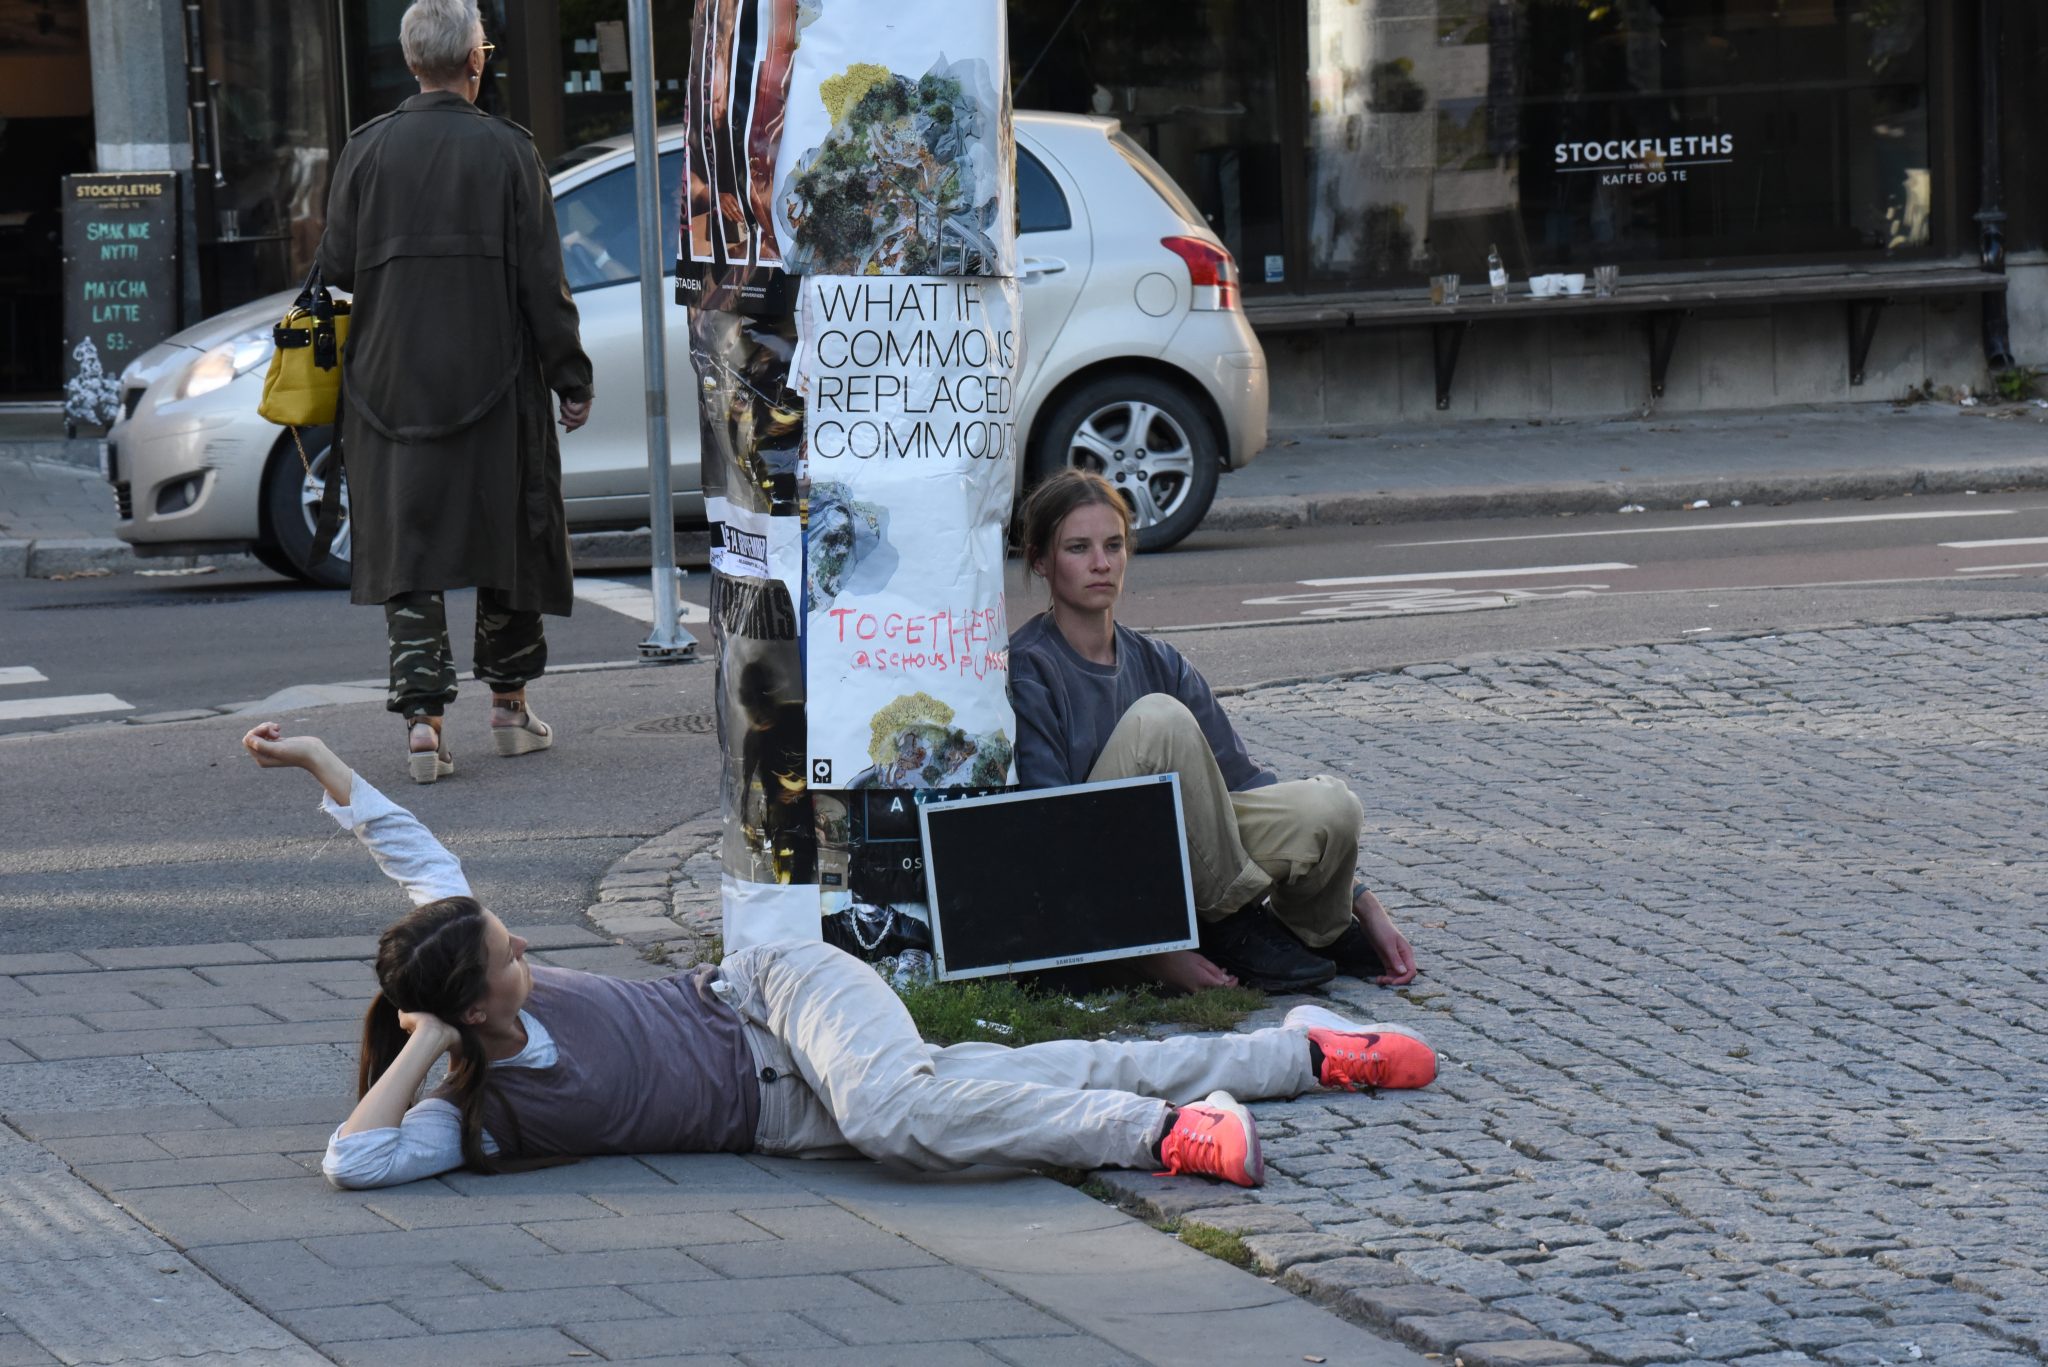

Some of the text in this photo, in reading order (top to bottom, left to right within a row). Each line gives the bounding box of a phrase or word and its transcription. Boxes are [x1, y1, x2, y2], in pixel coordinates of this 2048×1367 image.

[1554, 134, 1733, 163] STOCKFLETHS
[1602, 170, 1687, 185] KAFFE OG TE
[76, 184, 162, 197] STOCKFLETHS
[87, 222, 150, 240] SMAK NOE
[84, 280, 148, 300] MATCHA
[817, 283, 980, 322] WHAT IF
[92, 304, 140, 323] LATTE
[817, 329, 1015, 369] COMMONS
[817, 375, 1012, 414] REPLACED
[813, 420, 1016, 460] COMMODIT
[1056, 957, 1084, 965] SAMSUNG
